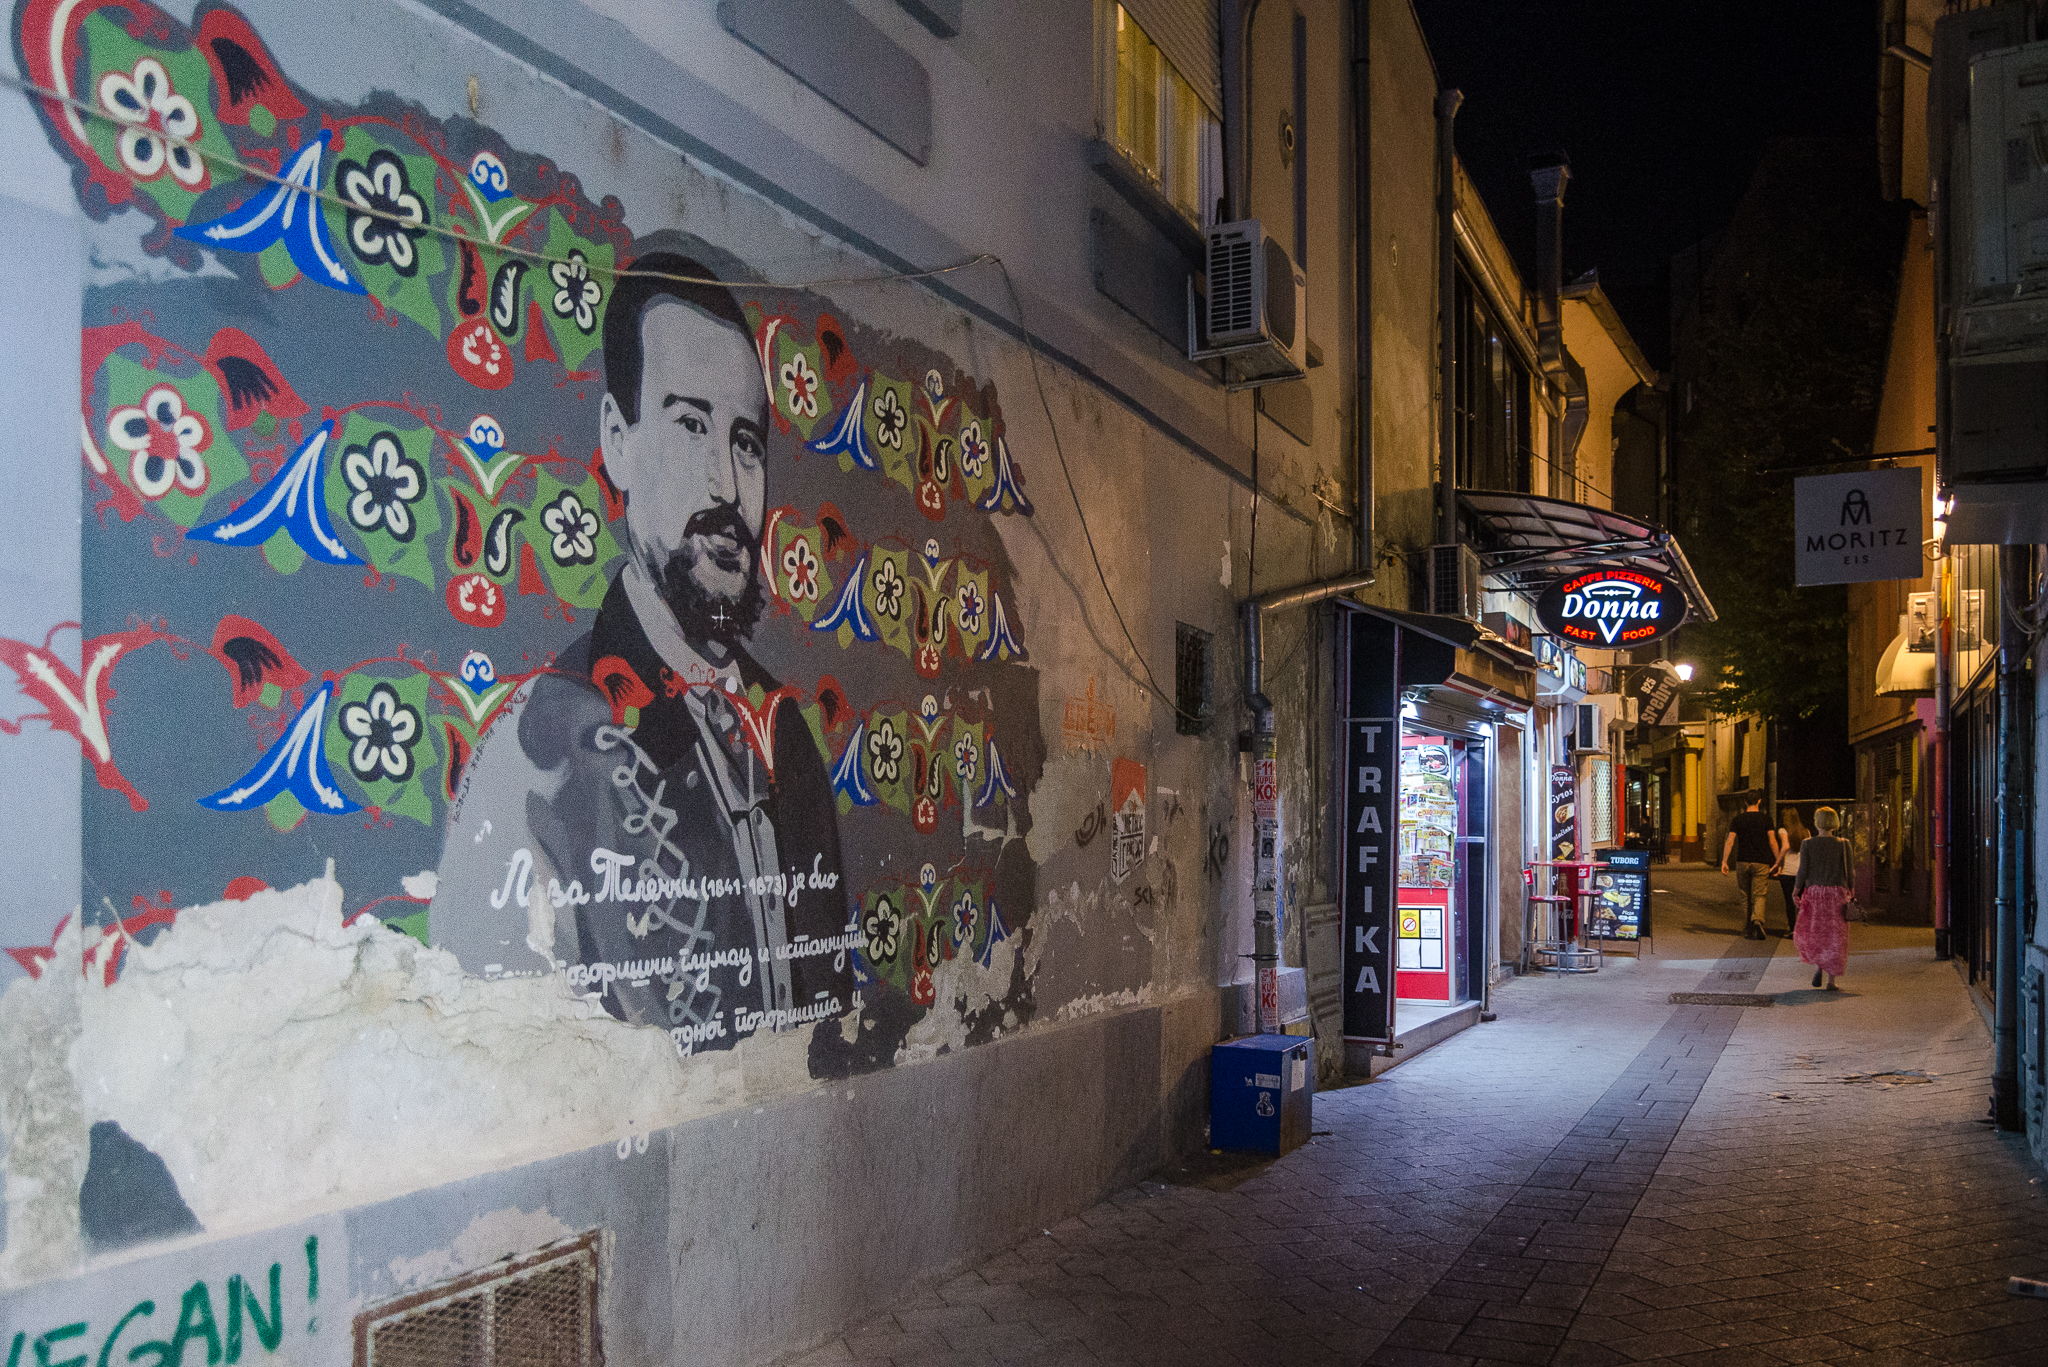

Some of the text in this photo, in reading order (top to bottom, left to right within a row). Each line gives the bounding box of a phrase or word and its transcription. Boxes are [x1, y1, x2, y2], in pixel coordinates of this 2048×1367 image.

[1806, 528, 1908, 552] MORITZ
[1844, 554, 1869, 565] EIS
[1563, 570, 1663, 594] CAFFE PIZZERIA
[1561, 593, 1660, 619] Donna
[1563, 624, 1656, 641] FAST FOOD
[1640, 676, 1657, 694] 925
[1640, 675, 1678, 725] srebro
[1551, 788, 1574, 804] Gyros
[1551, 824, 1575, 842] alačinke
[1354, 725, 1383, 994] TRAFIKA
[1610, 856, 1639, 865] TUBORG
[491, 847, 590, 909] Лза
